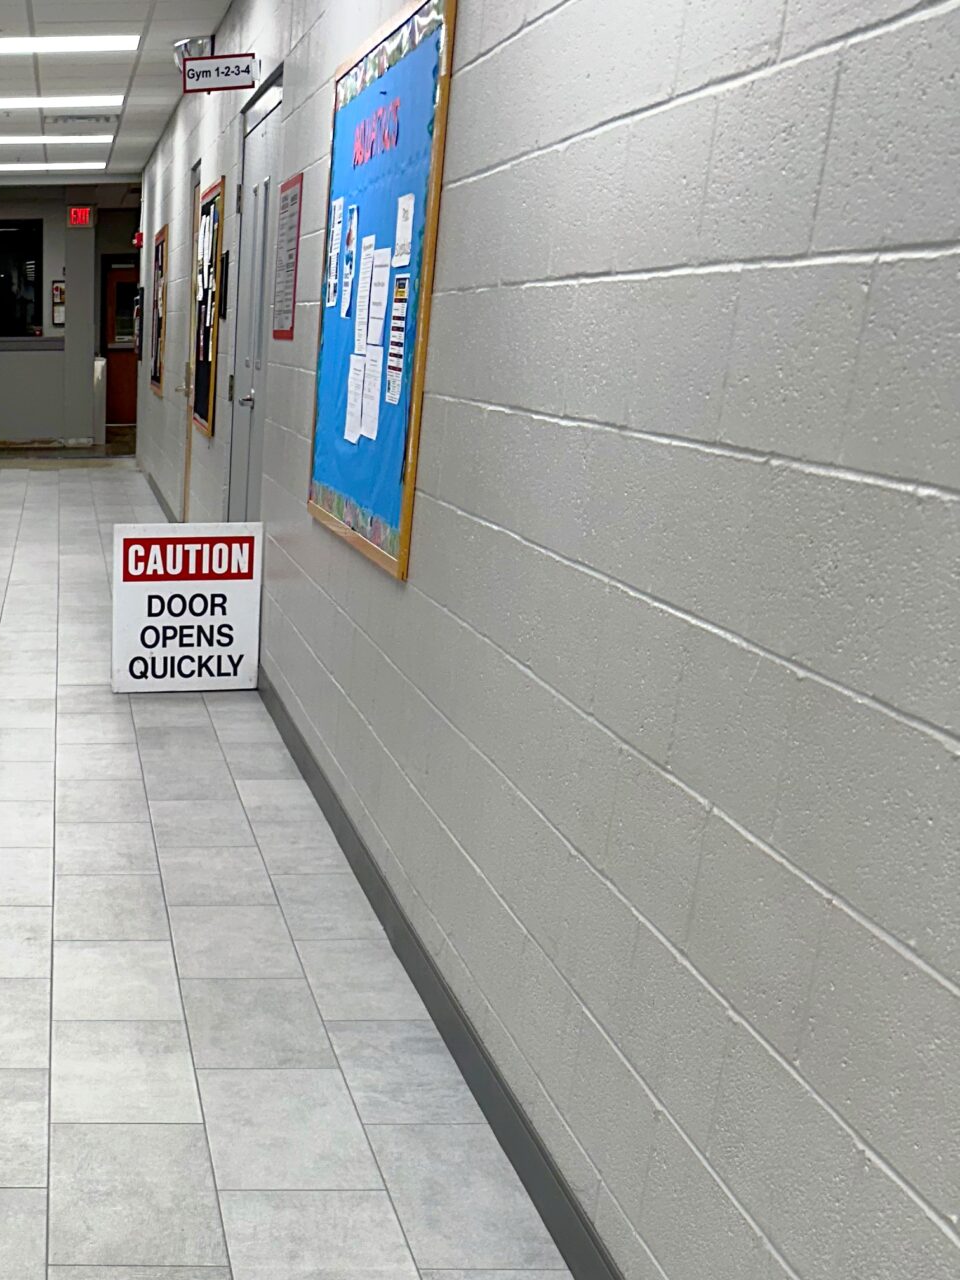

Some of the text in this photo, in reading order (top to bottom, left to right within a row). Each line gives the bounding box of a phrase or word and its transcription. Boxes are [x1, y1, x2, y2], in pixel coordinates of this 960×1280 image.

[187, 64, 250, 81] Gym 1-2-3-4
[71, 207, 90, 225] EXIT
[128, 543, 250, 575] CAUTION
[147, 593, 228, 617] DOOR
[140, 623, 234, 649] OPENS
[128, 654, 245, 680] QUICKLY
